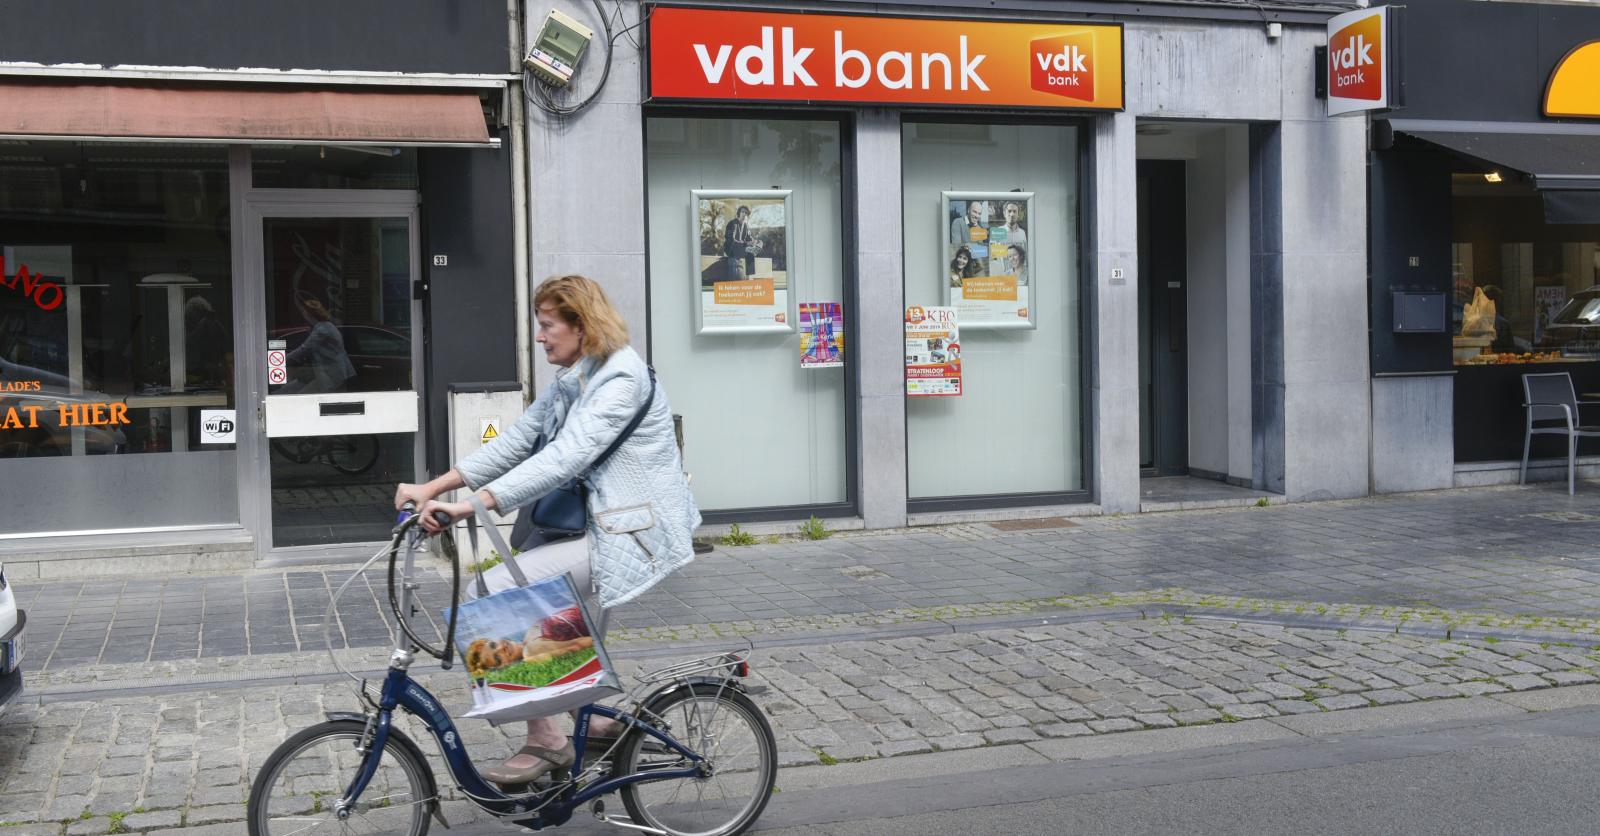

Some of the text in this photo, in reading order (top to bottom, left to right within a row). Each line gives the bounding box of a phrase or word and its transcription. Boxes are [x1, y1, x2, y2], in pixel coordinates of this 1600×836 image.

[693, 26, 991, 91] vdk bank
[1036, 44, 1087, 73] vdk
[1332, 34, 1374, 71] vdk
[1047, 73, 1079, 87] bank
[1337, 69, 1365, 87] bank
[435, 256, 445, 265] 33
[58, 401, 131, 428] HIER
